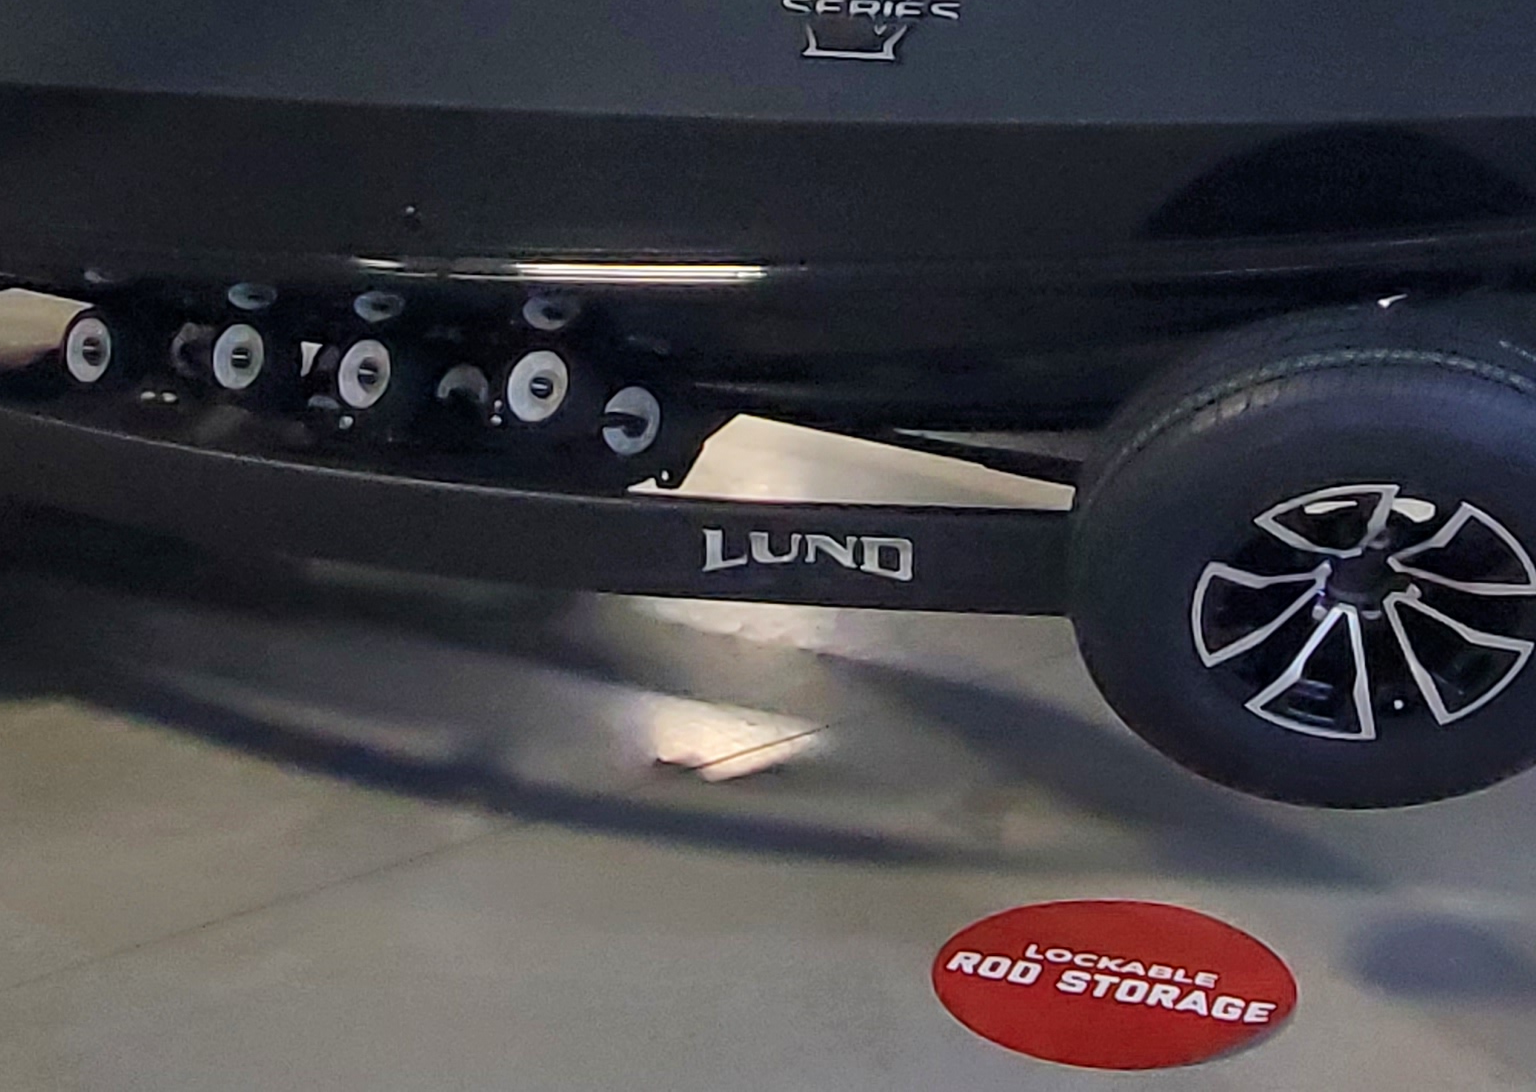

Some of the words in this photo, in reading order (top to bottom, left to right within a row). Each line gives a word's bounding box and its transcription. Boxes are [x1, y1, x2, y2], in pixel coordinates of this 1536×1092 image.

[702, 528, 914, 582] LUND
[946, 951, 1043, 985] ROD
[1055, 970, 1277, 1023] STORAGE
[1024, 943, 1219, 988] LOCKABLE
